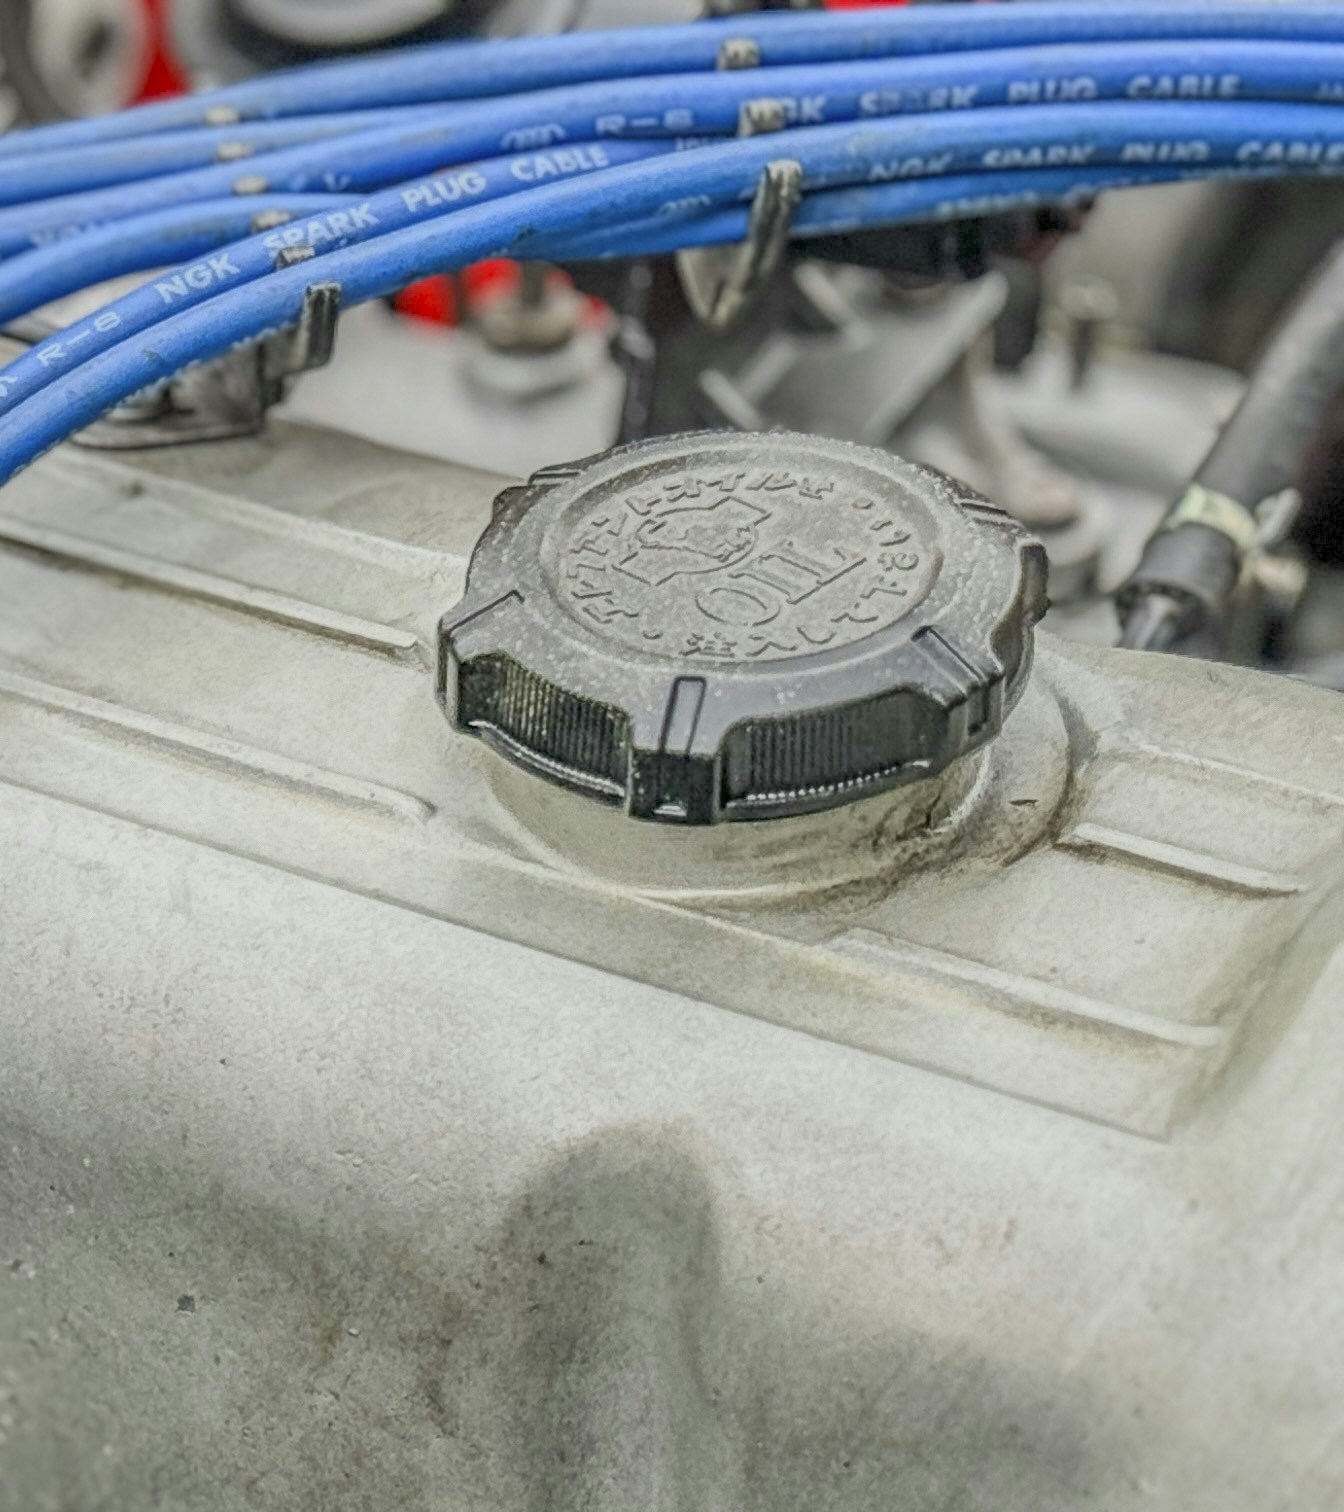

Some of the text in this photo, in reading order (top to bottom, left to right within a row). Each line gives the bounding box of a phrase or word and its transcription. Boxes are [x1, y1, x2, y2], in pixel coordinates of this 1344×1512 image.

[1126, 73, 1243, 99] CABLE
[36, 310, 121, 367] R-8
[153, 252, 241, 304] NGK
[262, 201, 380, 258] SPARK
[399, 170, 487, 213] PLUG
[511, 144, 609, 182] CABLE
